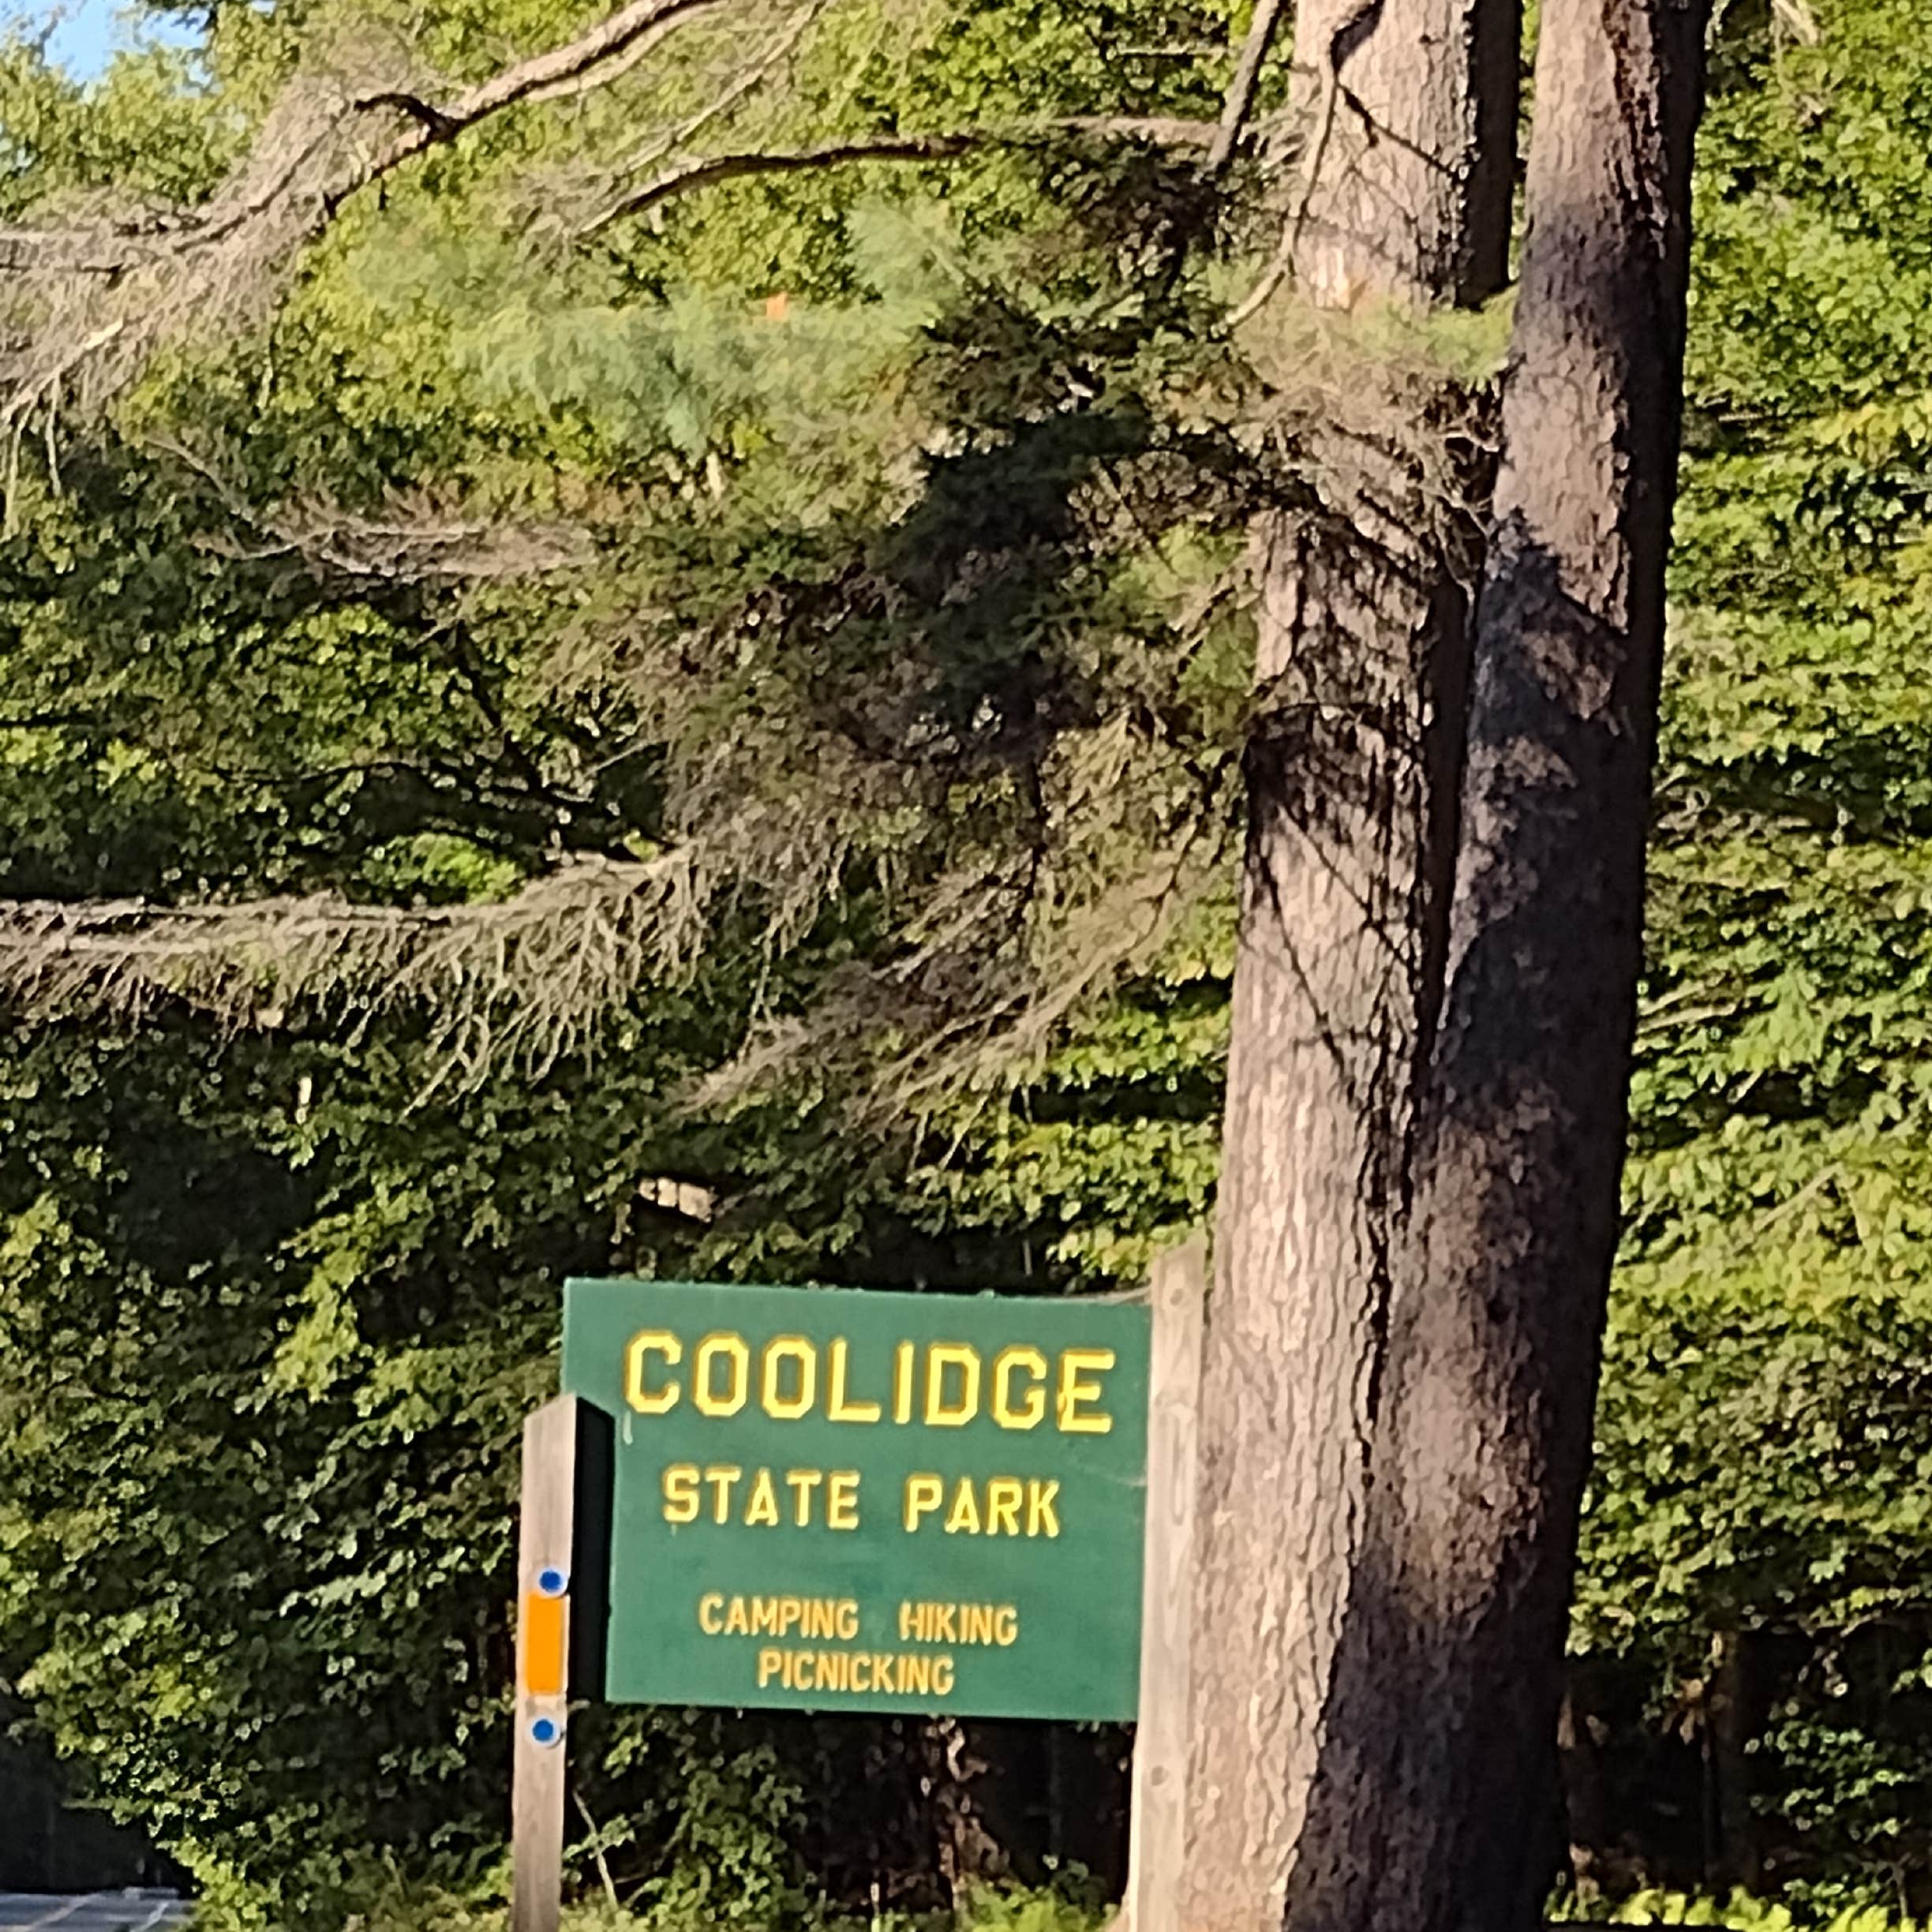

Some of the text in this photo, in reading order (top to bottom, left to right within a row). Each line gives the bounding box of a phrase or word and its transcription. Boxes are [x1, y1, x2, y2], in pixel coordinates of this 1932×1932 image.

[625, 1329, 1116, 1434] COOLIDGE
[662, 1463, 1060, 1537] STATE PARK
[698, 1594, 1018, 1646] CAMPING HIKING
[758, 1646, 955, 1696] PICNICKING
